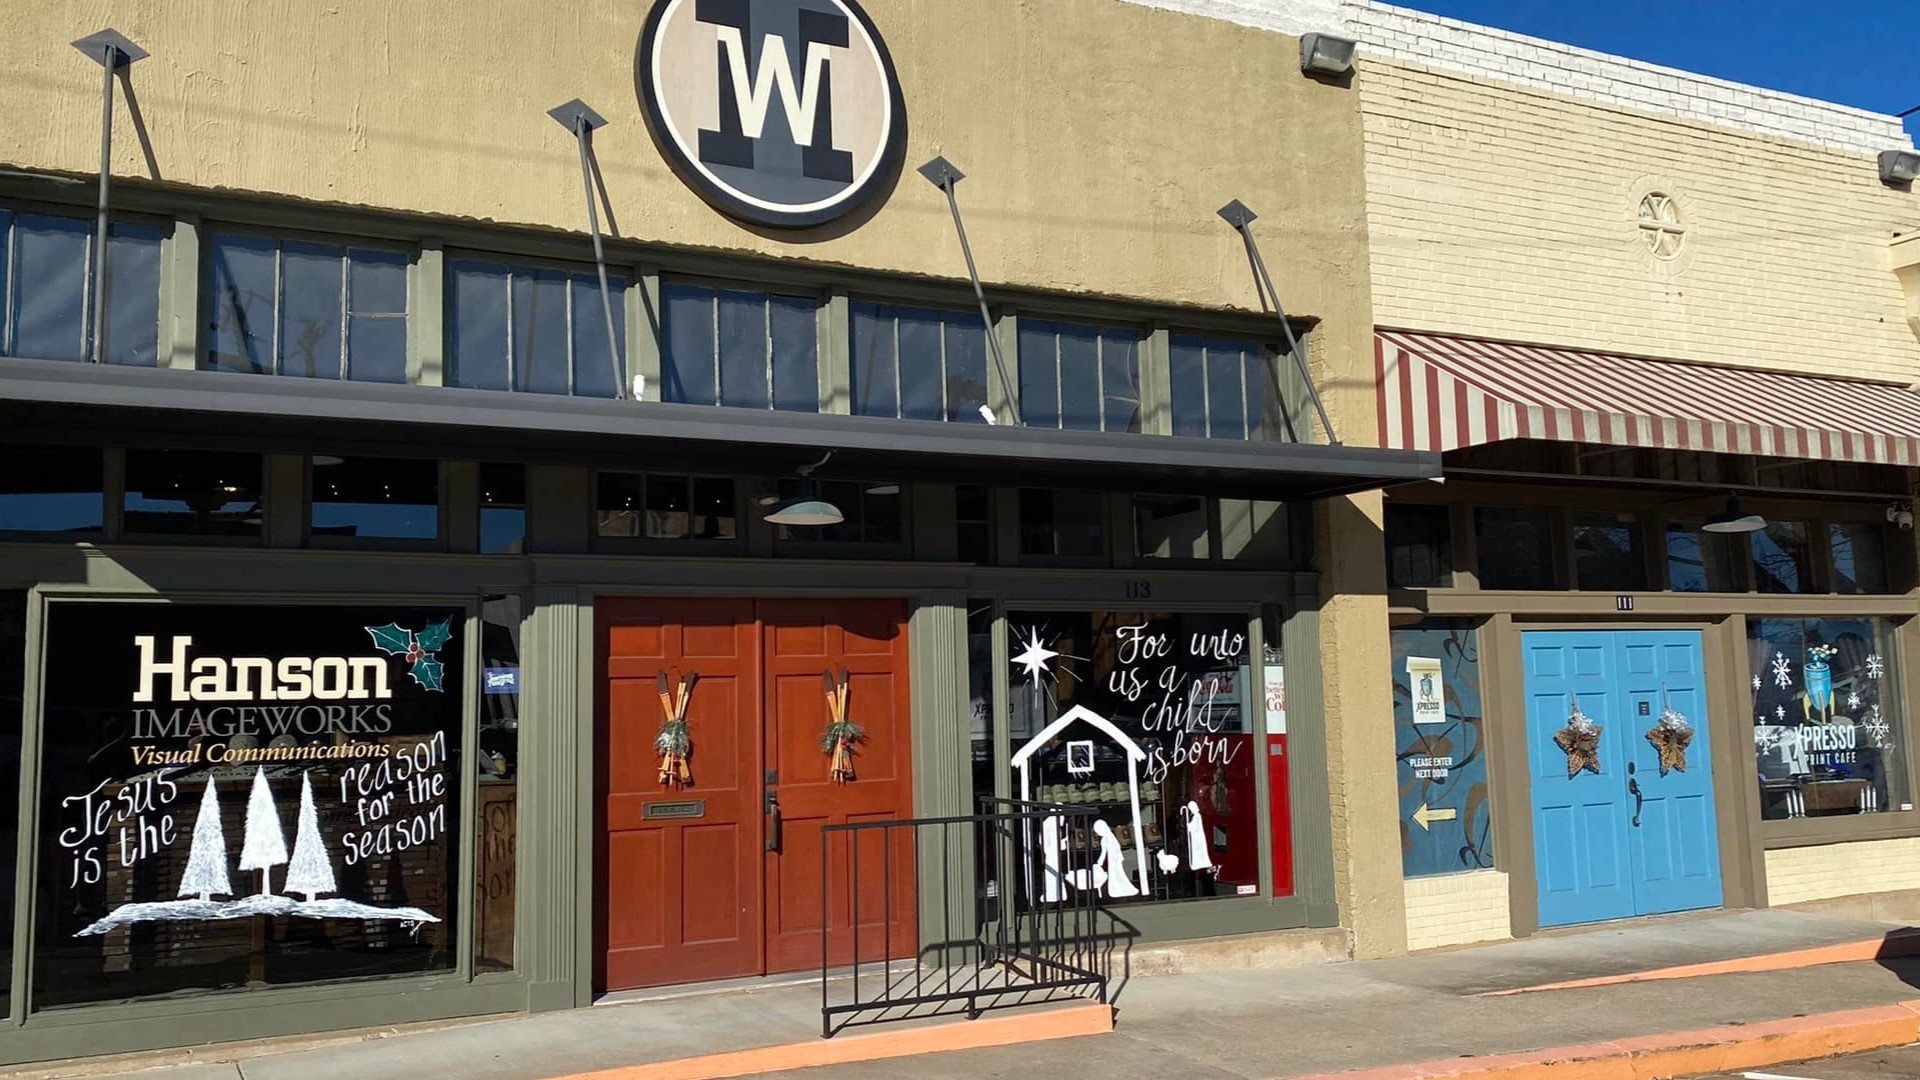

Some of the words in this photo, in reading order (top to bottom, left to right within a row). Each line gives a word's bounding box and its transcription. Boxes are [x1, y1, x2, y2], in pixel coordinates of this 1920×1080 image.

[1124, 581, 1151, 599] 113
[1617, 596, 1633, 610] 111
[1116, 622, 1174, 664] For
[1189, 629, 1245, 660] unto
[133, 635, 393, 702] Hanson
[1109, 667, 1149, 701] us
[1159, 665, 1187, 693] a
[131, 704, 392, 739] IMAGEWORKS
[1142, 678, 1233, 733] child
[132, 743, 201, 766] Visual
[206, 739, 391, 764] Communications
[1143, 744, 1170, 785] is
[1171, 729, 1243, 766] born
[1793, 722, 1856, 760] XPRESSO
[1805, 753, 1831, 767] PRINT
[1834, 751, 1857, 765] CAFE
[340, 730, 446, 803] reason
[1409, 757, 1433, 768] PLEASE
[1433, 757, 1453, 767] ENTER
[1415, 769, 1431, 779] NEXT
[1432, 768, 1449, 778] DOOR
[60, 767, 180, 847] Jesus
[354, 791, 394, 827] for
[405, 772, 445, 805] the
[70, 847, 101, 889] is
[116, 814, 177, 867] the
[342, 803, 444, 866] season
